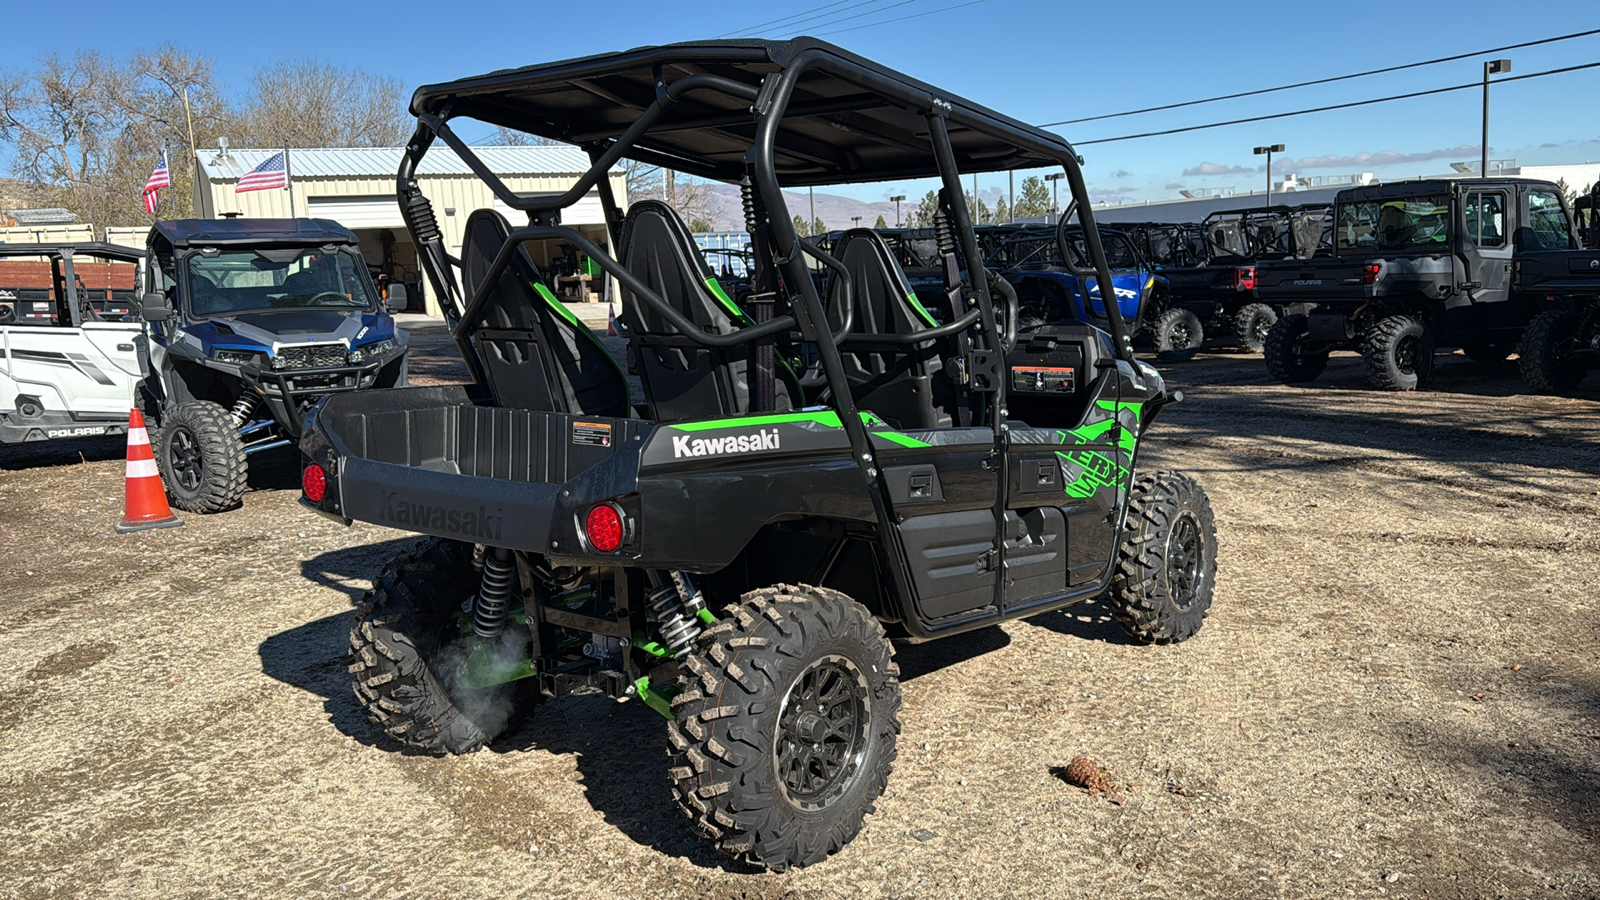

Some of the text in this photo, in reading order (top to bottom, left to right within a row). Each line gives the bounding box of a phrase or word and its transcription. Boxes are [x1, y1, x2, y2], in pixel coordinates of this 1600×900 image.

[48, 427, 105, 438] POLARIS
[672, 428, 780, 458] Kawasaki
[379, 490, 504, 540] Kawasaki
